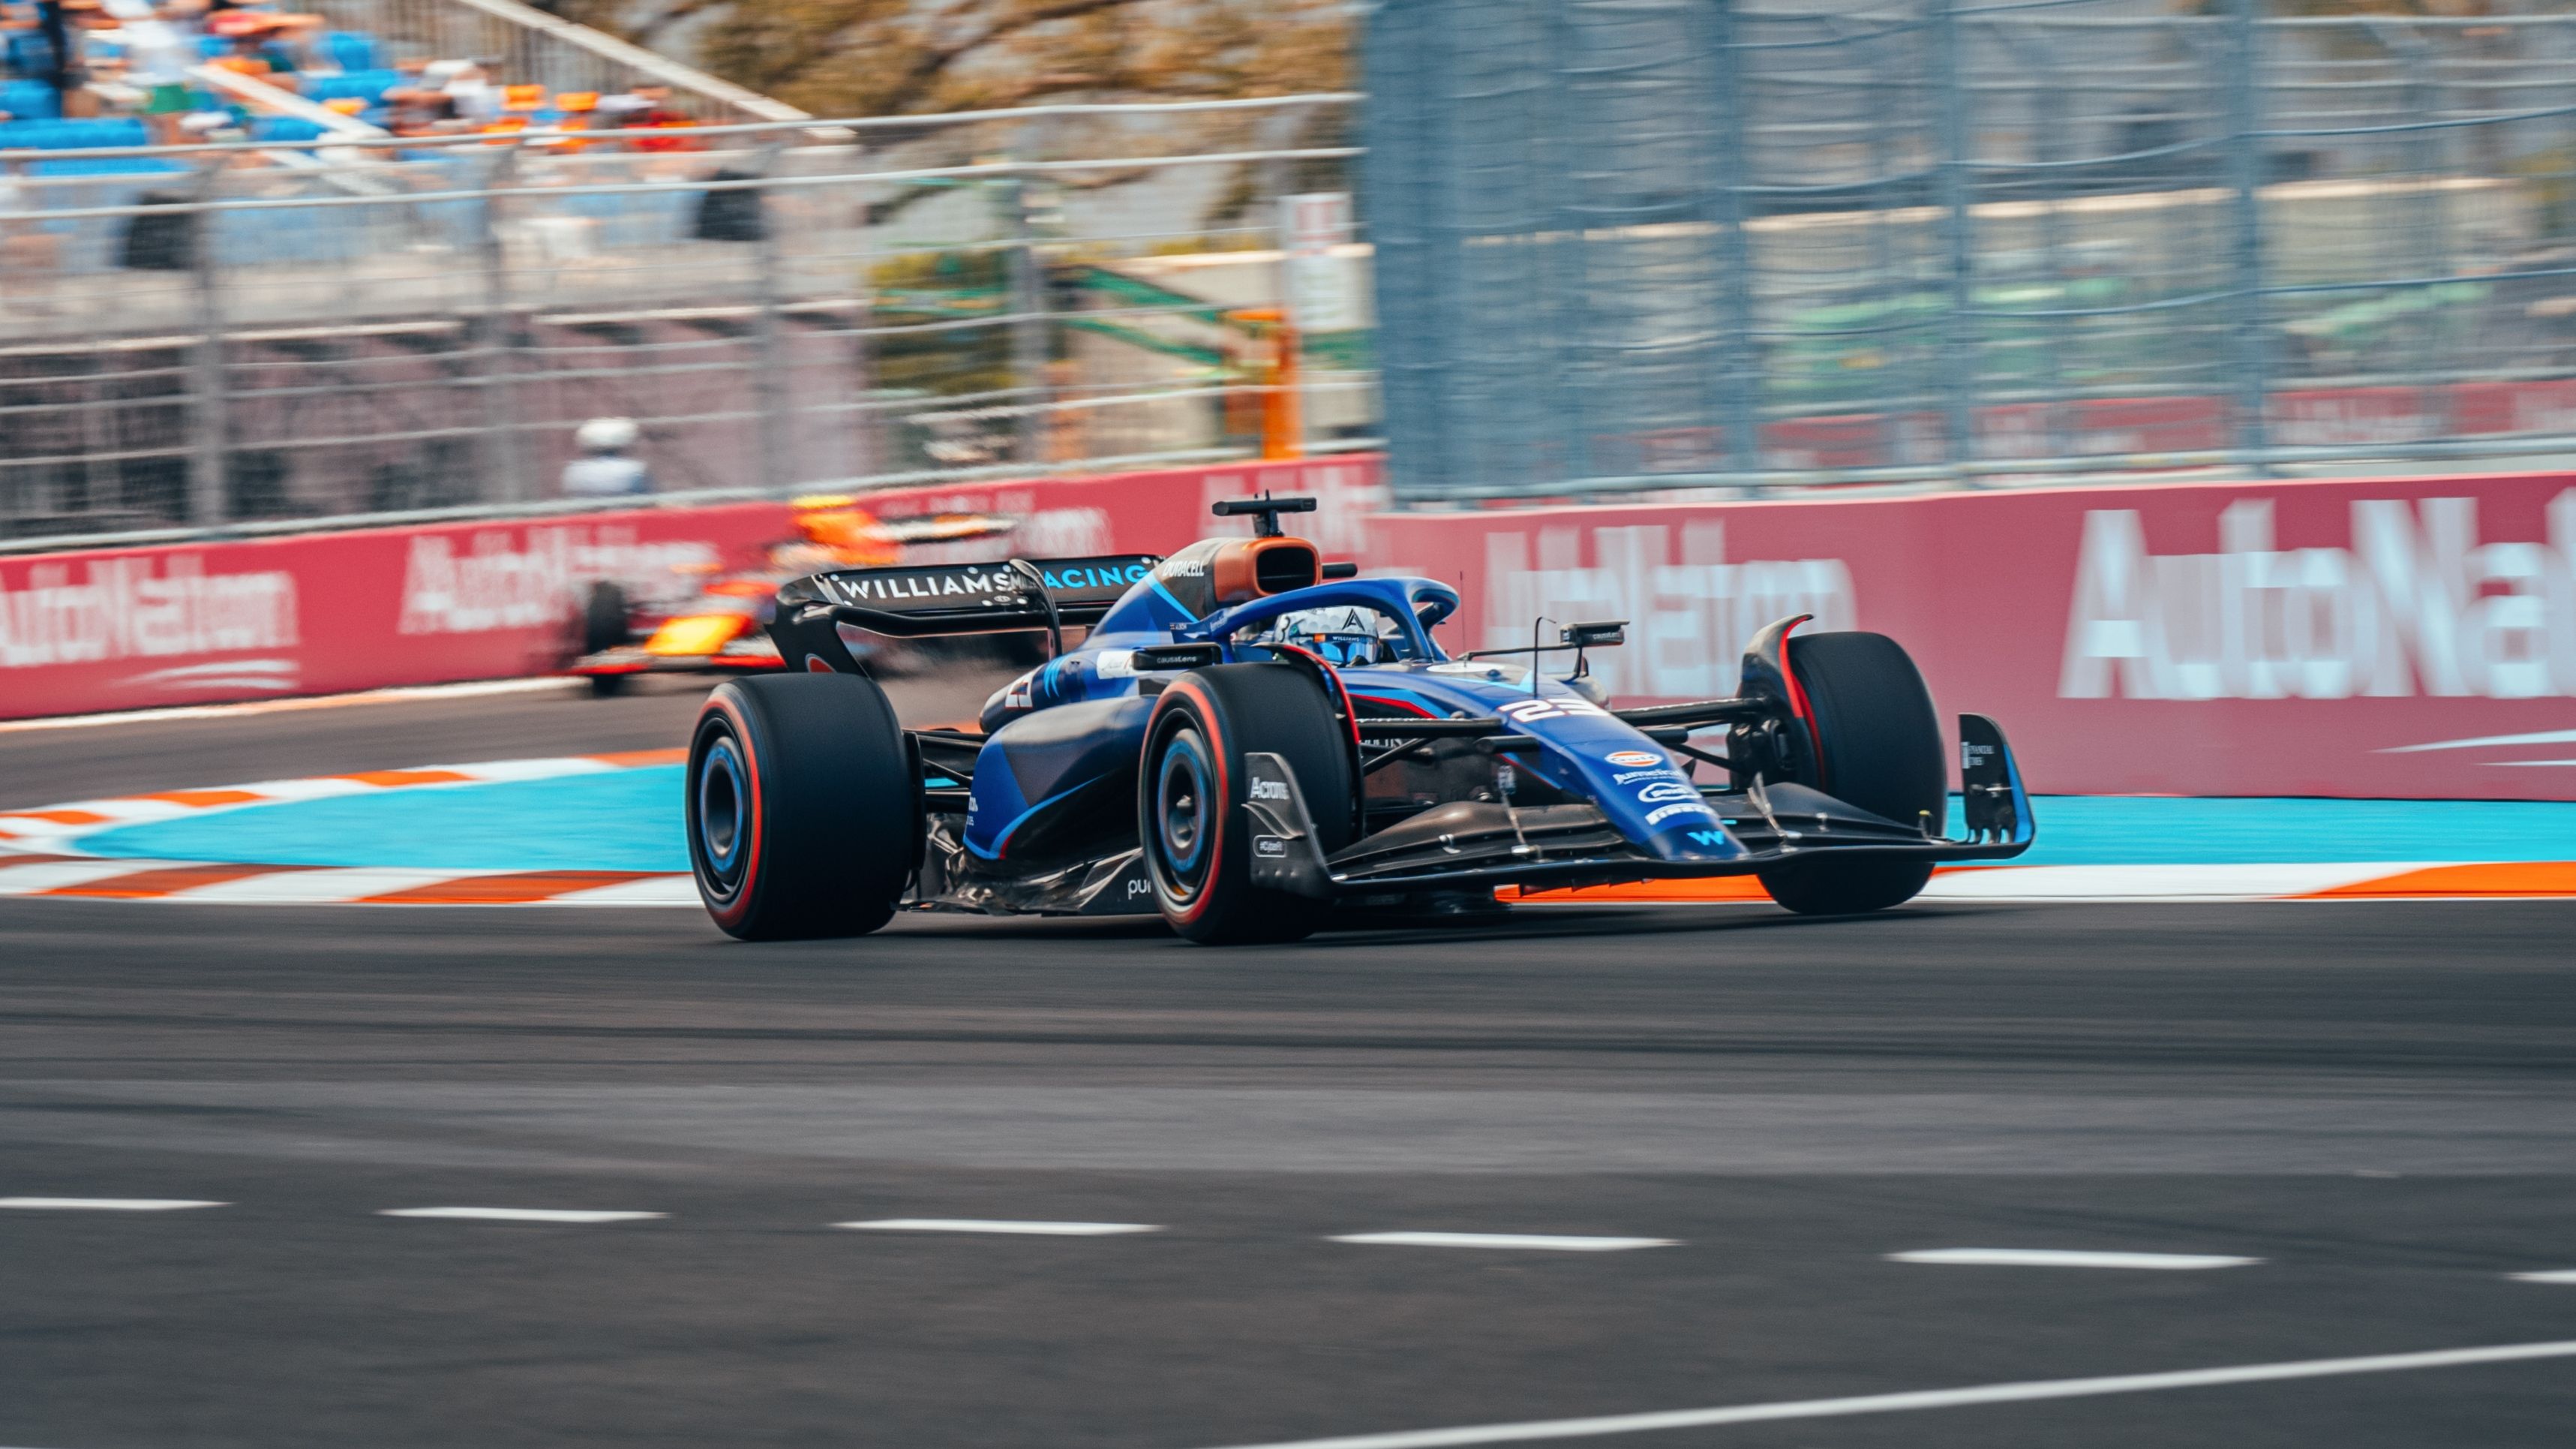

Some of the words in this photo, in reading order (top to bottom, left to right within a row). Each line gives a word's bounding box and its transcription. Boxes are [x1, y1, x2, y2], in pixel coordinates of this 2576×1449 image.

[1163, 560, 1205, 577] DURACELL
[837, 572, 1011, 600] WILLIAMS
[1043, 564, 1150, 590] ACING
[1497, 698, 1612, 723] 23
